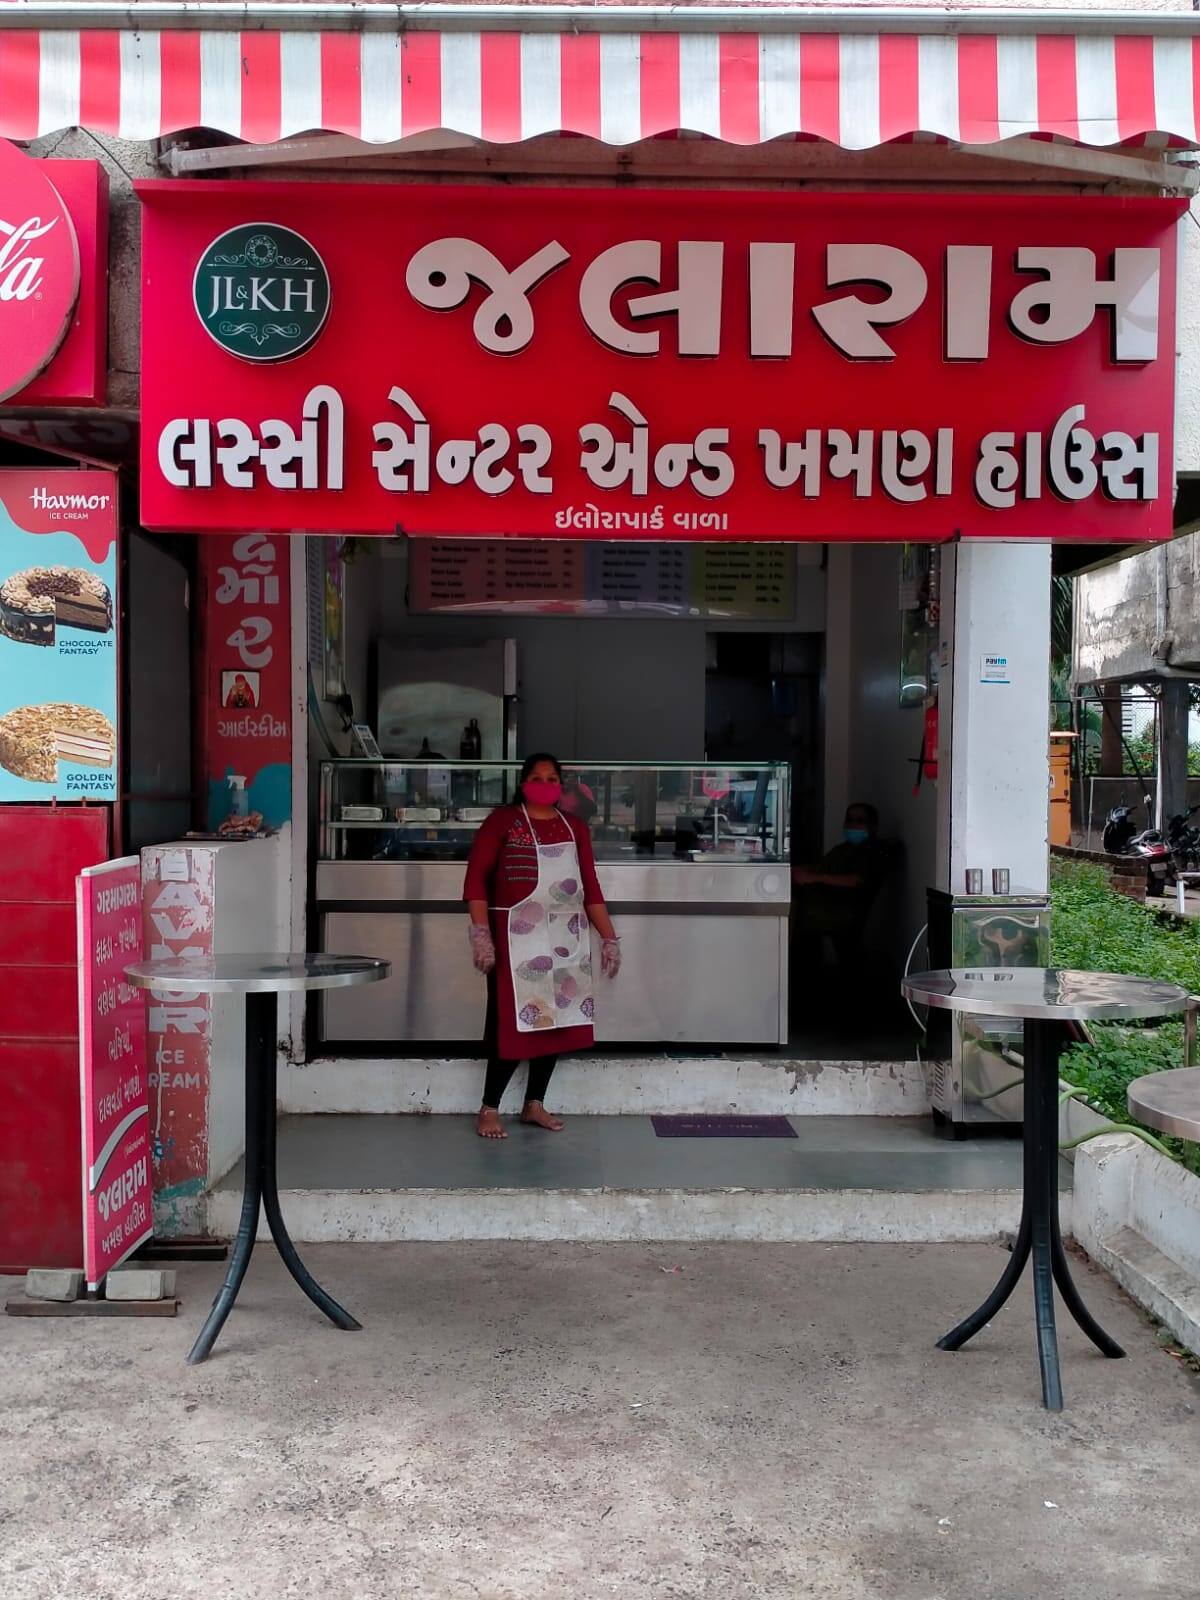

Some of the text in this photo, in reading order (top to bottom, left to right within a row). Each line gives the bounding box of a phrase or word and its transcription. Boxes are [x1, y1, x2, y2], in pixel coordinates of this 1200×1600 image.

[0, 216, 59, 301] la
[207, 275, 316, 319] JL&KH
[405, 236, 1160, 362] જલારામ
[157, 384, 1160, 509] લસ્સી સેન્ટર એન્ડ ખમણ હાઉસ
[29, 486, 110, 510] Havmor
[49, 512, 89, 520] ICE CREAM
[673, 511, 729, 531] વાળા
[66, 773, 113, 781] GOLDEN
[66, 782, 116, 790] FANTASY
[96, 881, 137, 915] ગરમાગરમ
[155, 1049, 185, 1064] ICE
[148, 1072, 200, 1089] REAM
[98, 1155, 148, 1222] જલારામ
[102, 1223, 123, 1255] ખમણ
